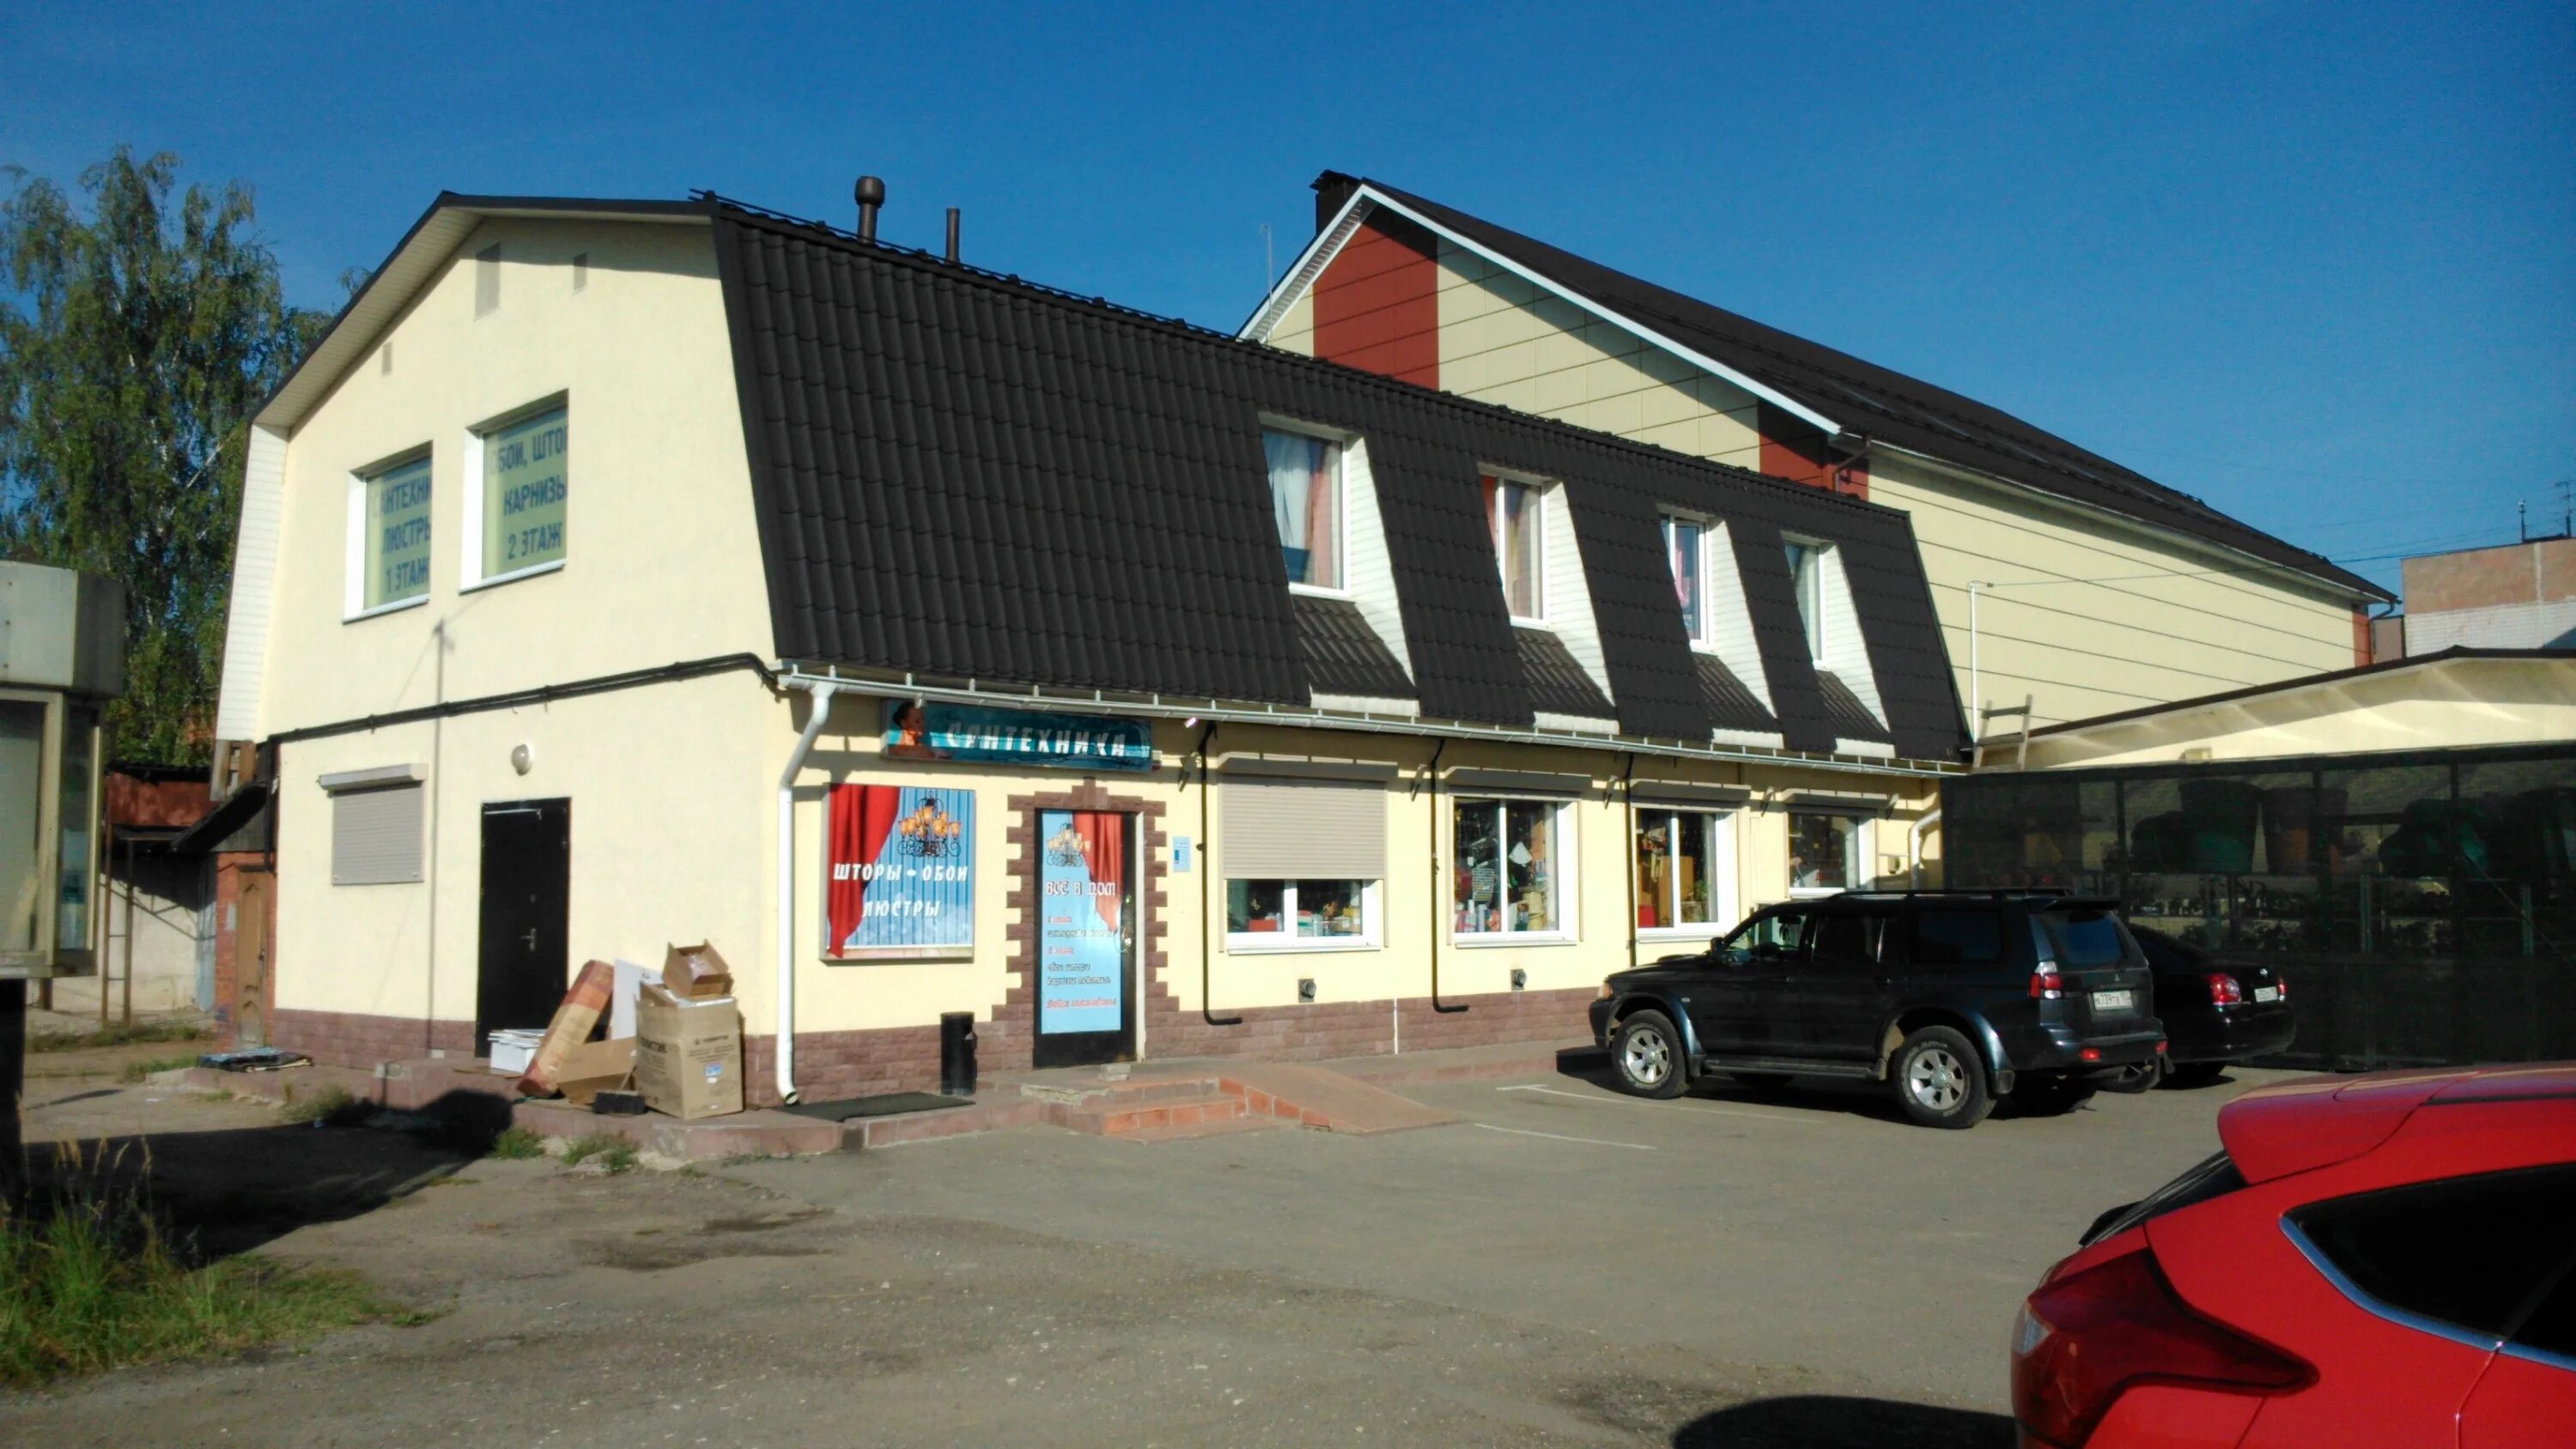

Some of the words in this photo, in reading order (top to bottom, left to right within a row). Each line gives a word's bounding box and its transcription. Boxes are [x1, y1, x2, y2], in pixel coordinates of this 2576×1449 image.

[507, 533, 517, 560] 2
[520, 521, 562, 557] ЭТАЖ
[946, 722, 1126, 757] САНТЕХНИКА
[833, 863, 902, 882] ШТОРЫ
[922, 864, 969, 882] ОБОИ
[1073, 881, 1083, 895] В
[862, 900, 941, 919] ЛЮСТРЫ
